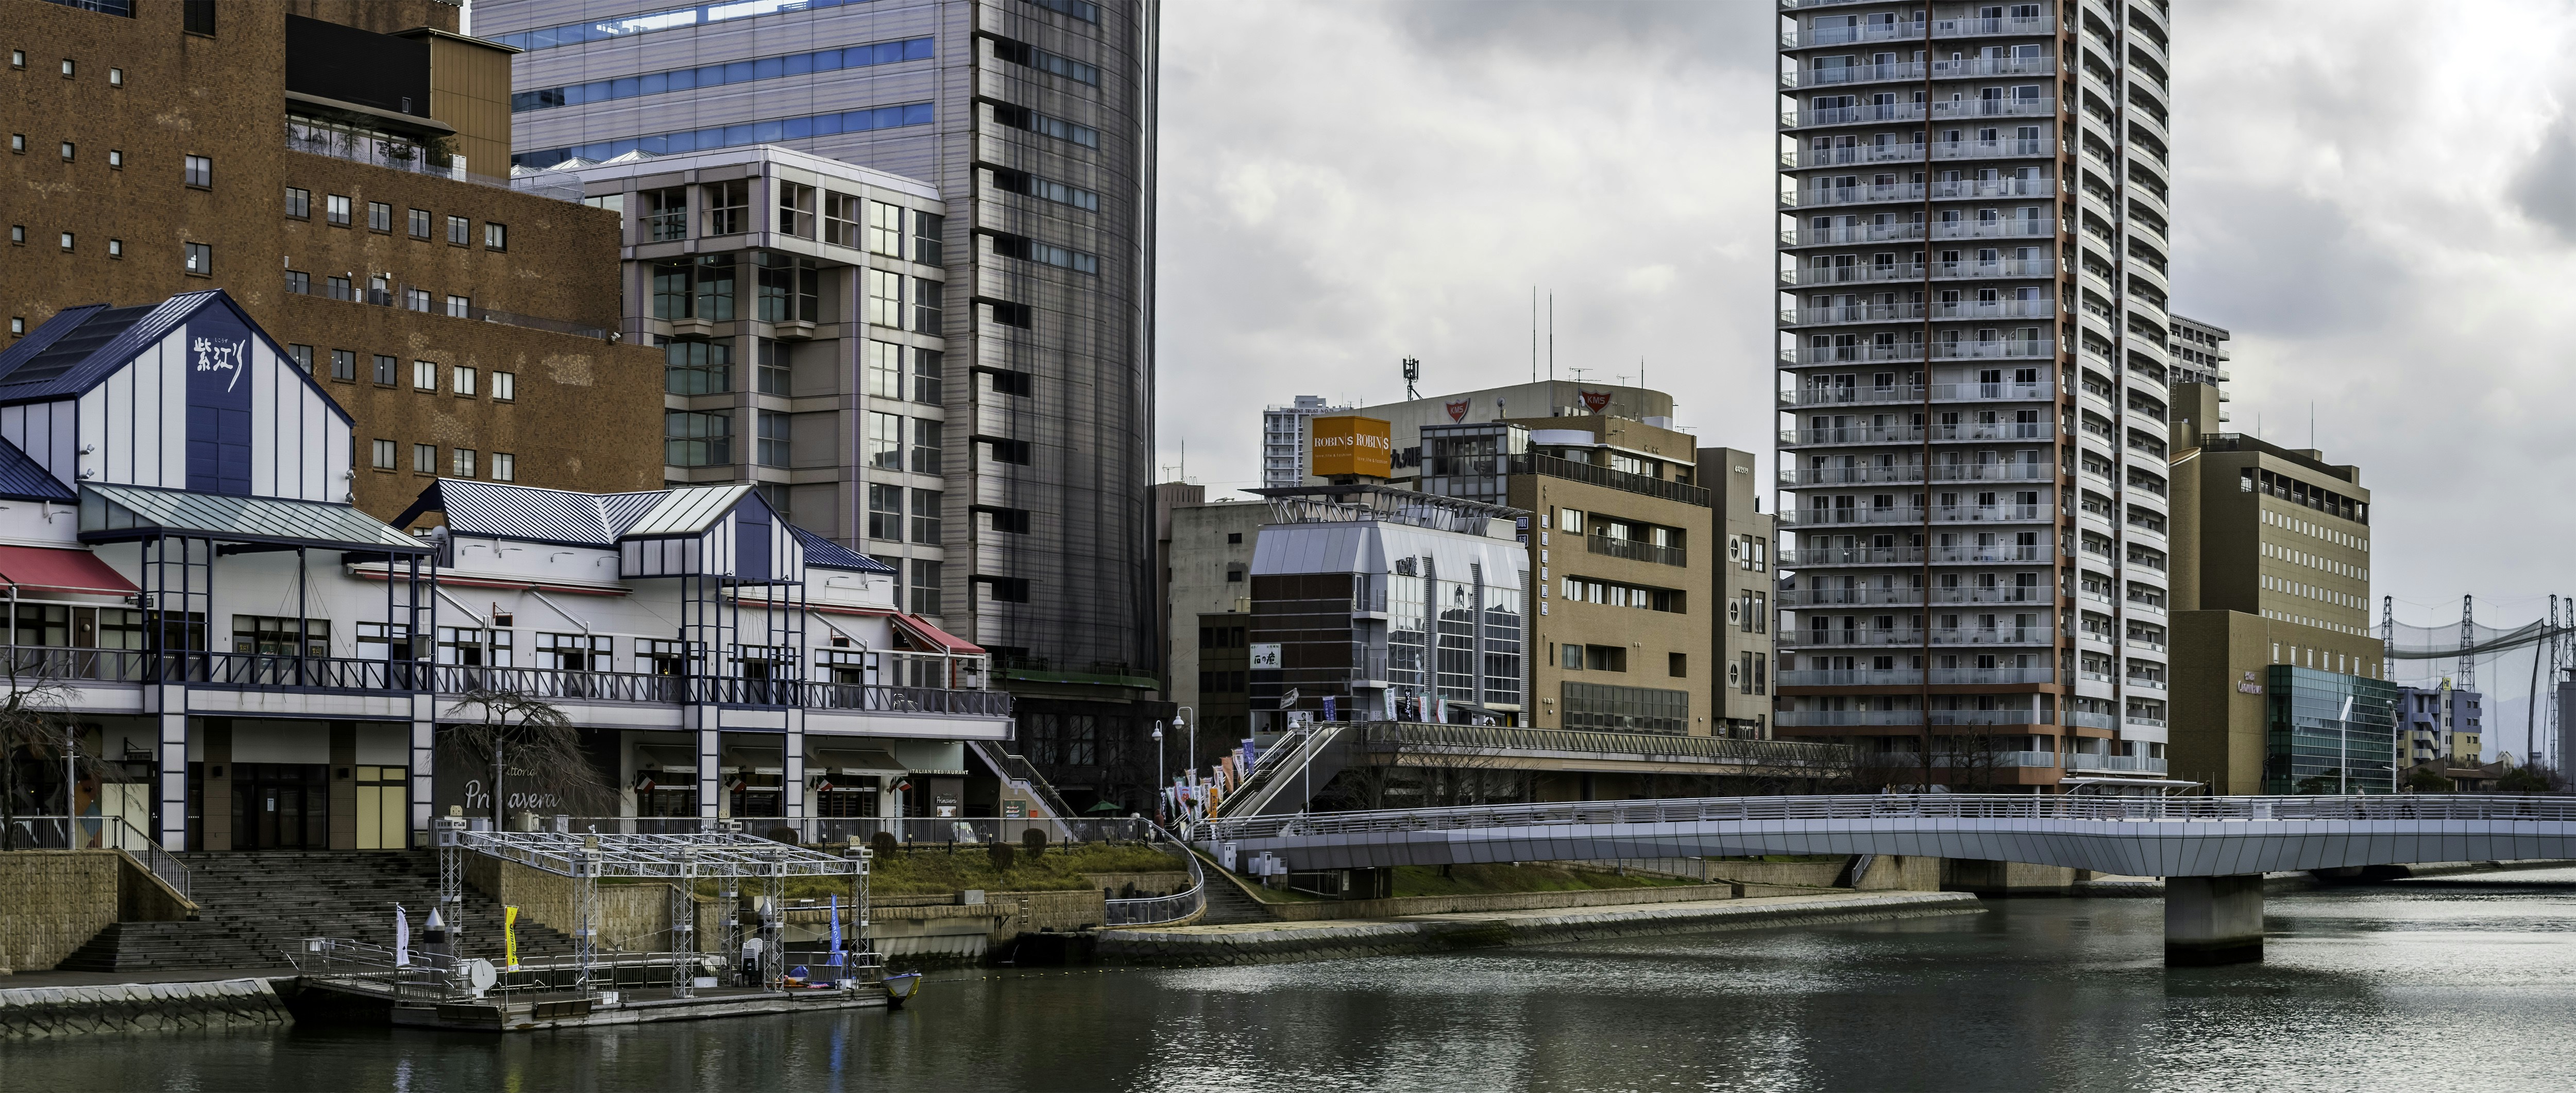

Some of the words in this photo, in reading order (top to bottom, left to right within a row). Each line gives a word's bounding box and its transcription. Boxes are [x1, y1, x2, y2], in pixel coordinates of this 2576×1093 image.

[1587, 396, 1605, 404] KMS
[1450, 405, 1464, 414] KMS
[465, 779, 560, 809] Priavera
[936, 796, 957, 804] Primavera
